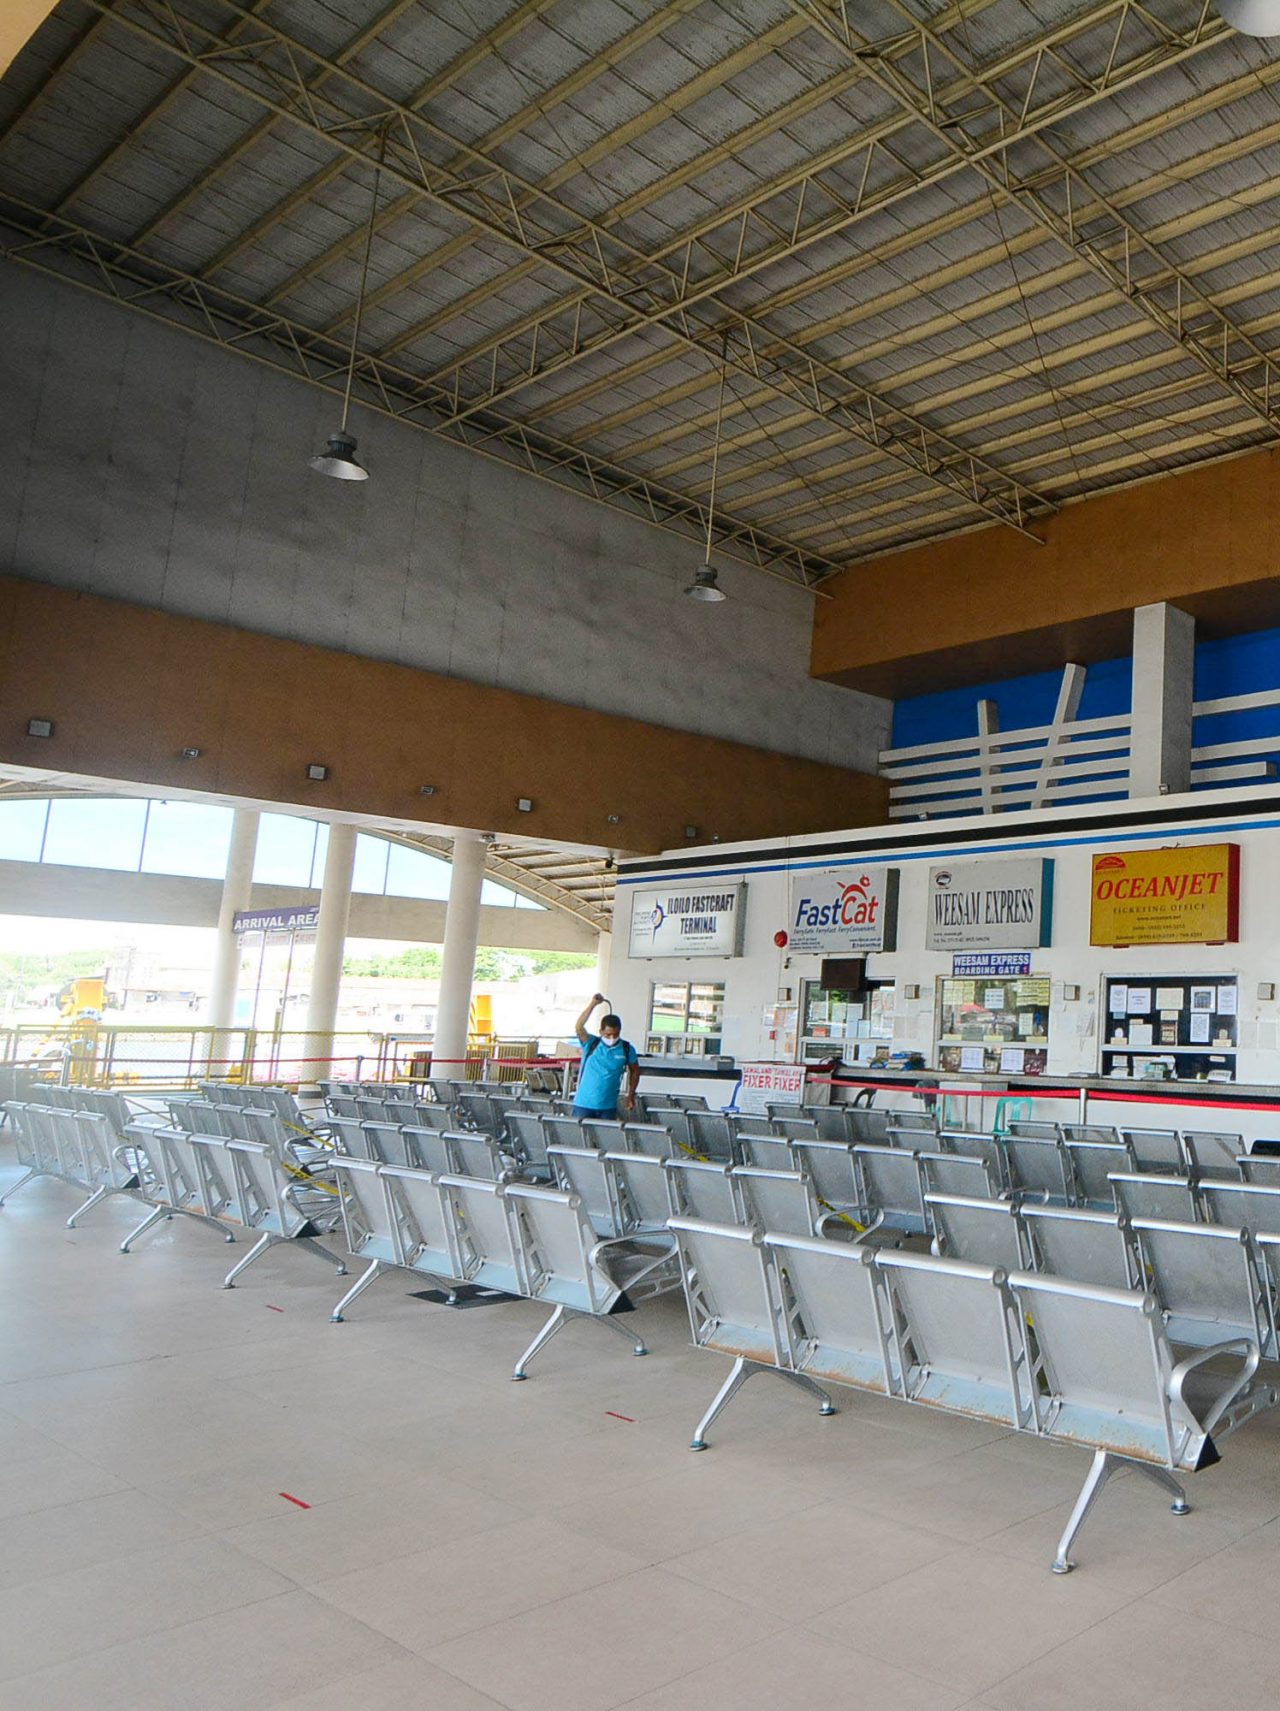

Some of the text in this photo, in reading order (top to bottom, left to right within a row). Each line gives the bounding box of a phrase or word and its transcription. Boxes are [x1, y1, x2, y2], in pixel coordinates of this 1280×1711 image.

[1096, 872, 1223, 900] OCEANJET
[667, 894, 735, 914] ILOILO FASTCRAFT
[796, 896, 878, 927] FastCat
[935, 888, 1034, 926] WEESAM EXPRESS
[1113, 903, 1206, 914] TICKETING OFFICE
[234, 913, 320, 930] ARRIVAL AREA
[681, 917, 716, 934] TERMINAL
[954, 954, 1029, 966] WEESAM EXPRESS
[955, 965, 996, 975] BOARDING
[998, 965, 1020, 974] GATE
[743, 1074, 772, 1089] FIXER
